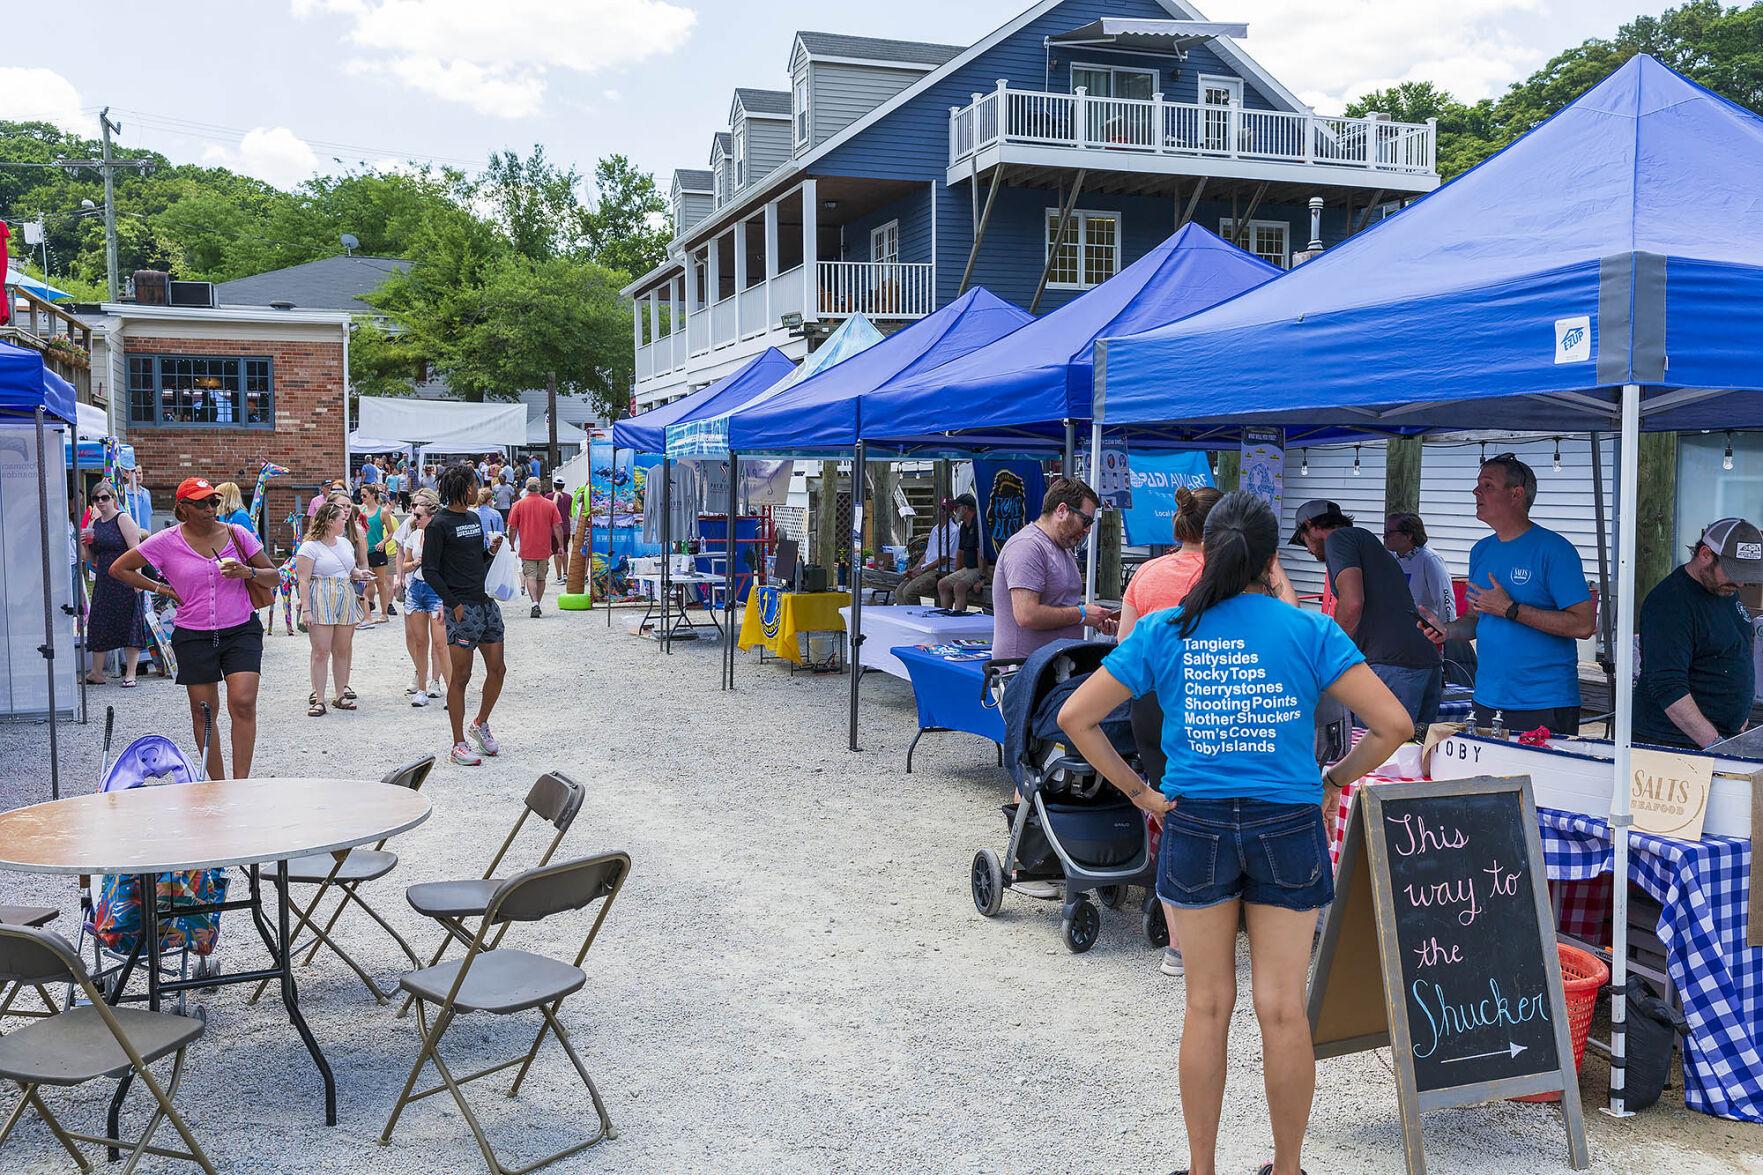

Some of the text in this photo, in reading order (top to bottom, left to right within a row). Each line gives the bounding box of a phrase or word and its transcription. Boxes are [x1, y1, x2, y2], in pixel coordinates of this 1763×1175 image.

[1183, 637, 1245, 652] Tangiers
[1183, 652, 1259, 667] Saltysides
[1184, 667, 1266, 683] Rocky Tops
[1185, 682, 1283, 697] Cherrystones
[1185, 695, 1297, 712] Shooting Points
[1184, 710, 1301, 725] Mother Shuckers
[1184, 727, 1277, 740] Tom's Coves
[1187, 740, 1276, 756] Toby Islands
[1632, 769, 1690, 804] SALTS
[1630, 799, 1685, 816] SEAFOOD
[1387, 814, 1469, 856] This
[1403, 860, 1522, 926] way to
[1413, 937, 1464, 969] the
[1412, 977, 1549, 1058] Shucker
